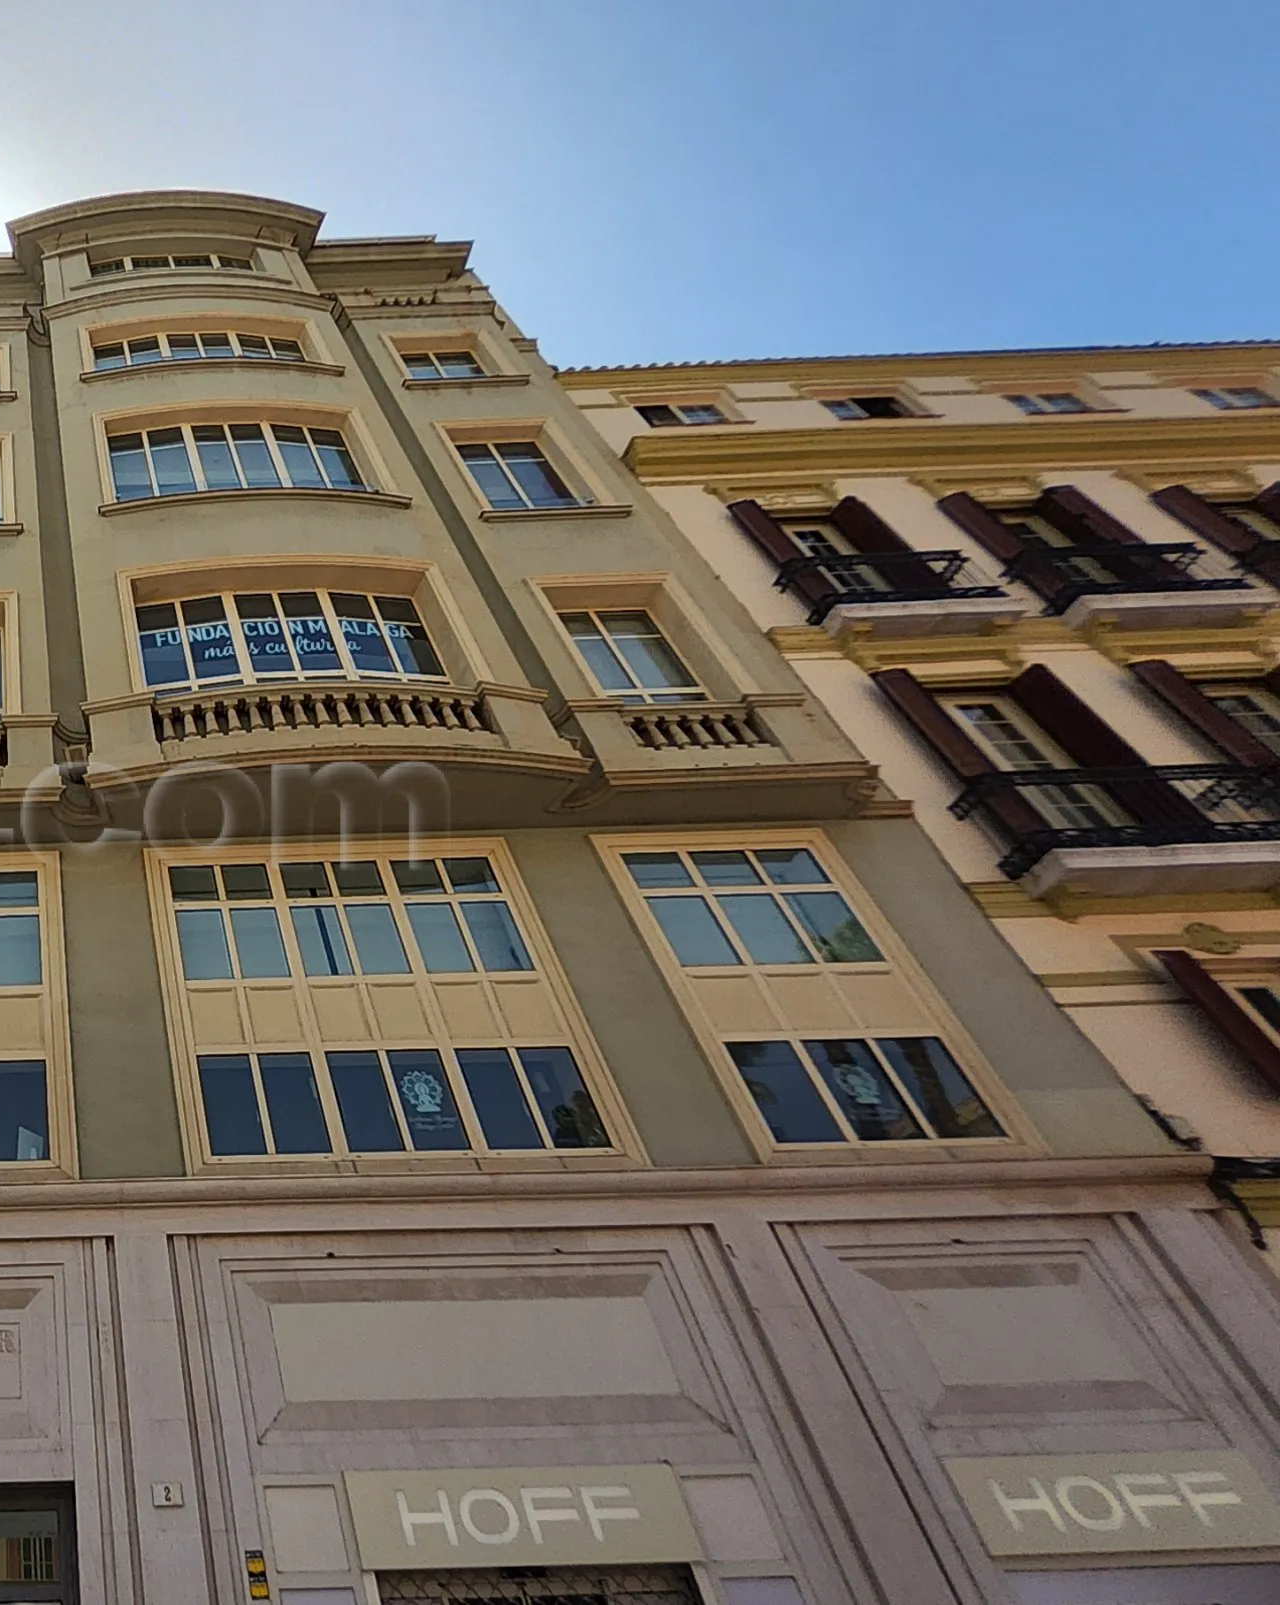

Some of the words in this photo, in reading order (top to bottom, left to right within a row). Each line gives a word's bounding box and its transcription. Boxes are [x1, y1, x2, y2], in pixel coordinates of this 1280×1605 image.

[155, 616, 304, 648] FUNDACIÓN
[310, 616, 415, 639] MÁLAGA
[266, 636, 362, 656] cultura
[163, 1485, 172, 1502] 2
[985, 1470, 1243, 1534] HOFF
[395, 1486, 642, 1547] HOFF
